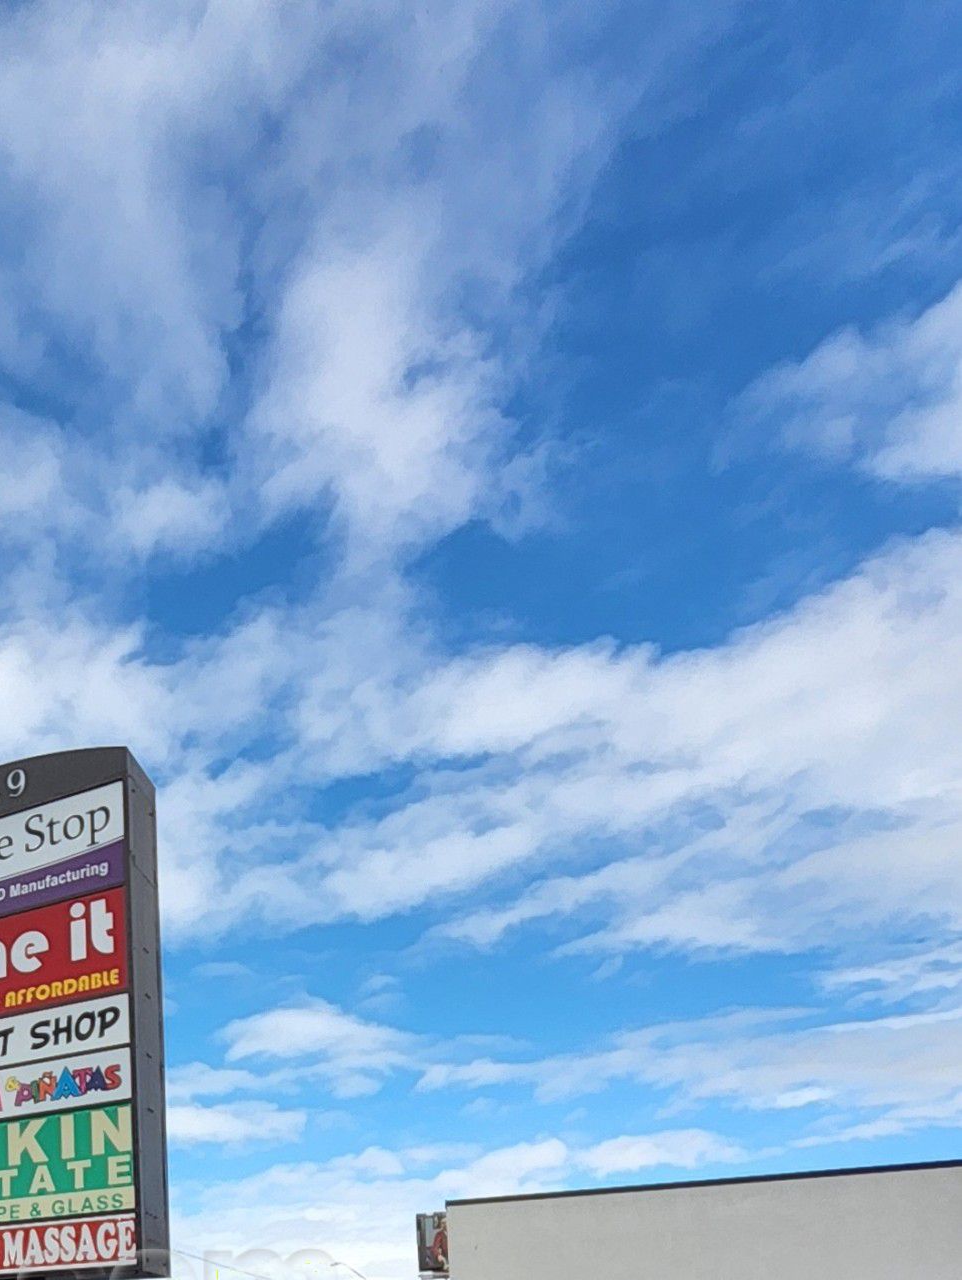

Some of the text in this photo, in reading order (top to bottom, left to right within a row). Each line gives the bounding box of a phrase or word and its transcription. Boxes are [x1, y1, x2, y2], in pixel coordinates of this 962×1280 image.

[24, 805, 111, 853] Stop
[9, 861, 110, 899] Manufacturing
[69, 898, 115, 962] it
[4, 968, 120, 1008] AFFORDABLE
[30, 1006, 121, 1050] SHOP
[14, 1063, 122, 1107] PIÑATAS
[29, 1202, 41, 1217] &
[51, 1193, 124, 1214] GLASS
[2, 1218, 138, 1269] MASSAGE
